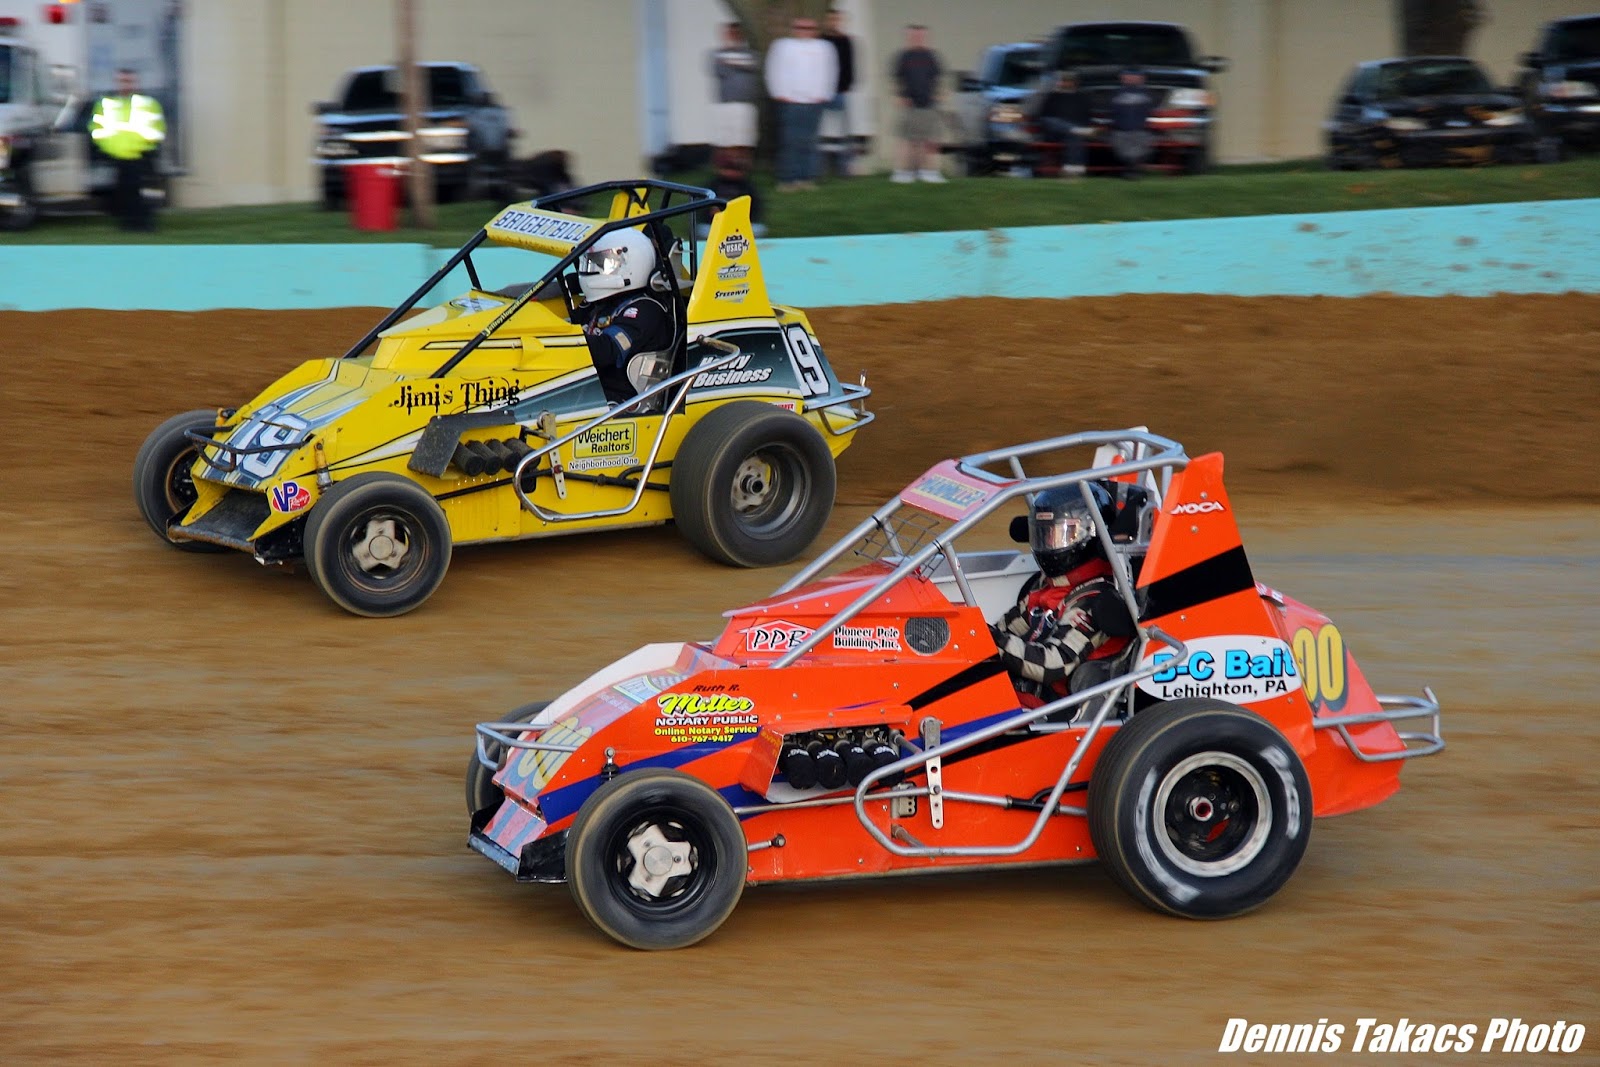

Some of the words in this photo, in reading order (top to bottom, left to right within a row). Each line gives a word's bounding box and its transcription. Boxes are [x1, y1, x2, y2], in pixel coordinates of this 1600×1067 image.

[493, 210, 590, 242] BRIGHTBILL
[726, 243, 742, 253] USAC
[692, 367, 772, 388] Business
[460, 379, 520, 414] Thing
[591, 441, 630, 454] Realtors
[569, 458, 621, 470] Neighborhood
[623, 457, 638, 465] One
[273, 481, 299, 512] VP
[753, 629, 806, 648] PPB
[835, 626, 873, 638] Pioneer
[877, 627, 899, 638] Pole
[1152, 650, 1215, 684] B-C
[1225, 647, 1297, 680] Bait
[693, 684, 726, 693] Ruth
[728, 684, 740, 692] R.
[1265, 680, 1288, 693] PA
[657, 693, 754, 716] Miller
[655, 716, 710, 726] NOTARY
[712, 714, 759, 725] PUBLIC
[654, 727, 686, 736] Online
[688, 726, 722, 736] Notary
[724, 726, 758, 735] Service
[670, 734, 734, 743] 610-767-9417
